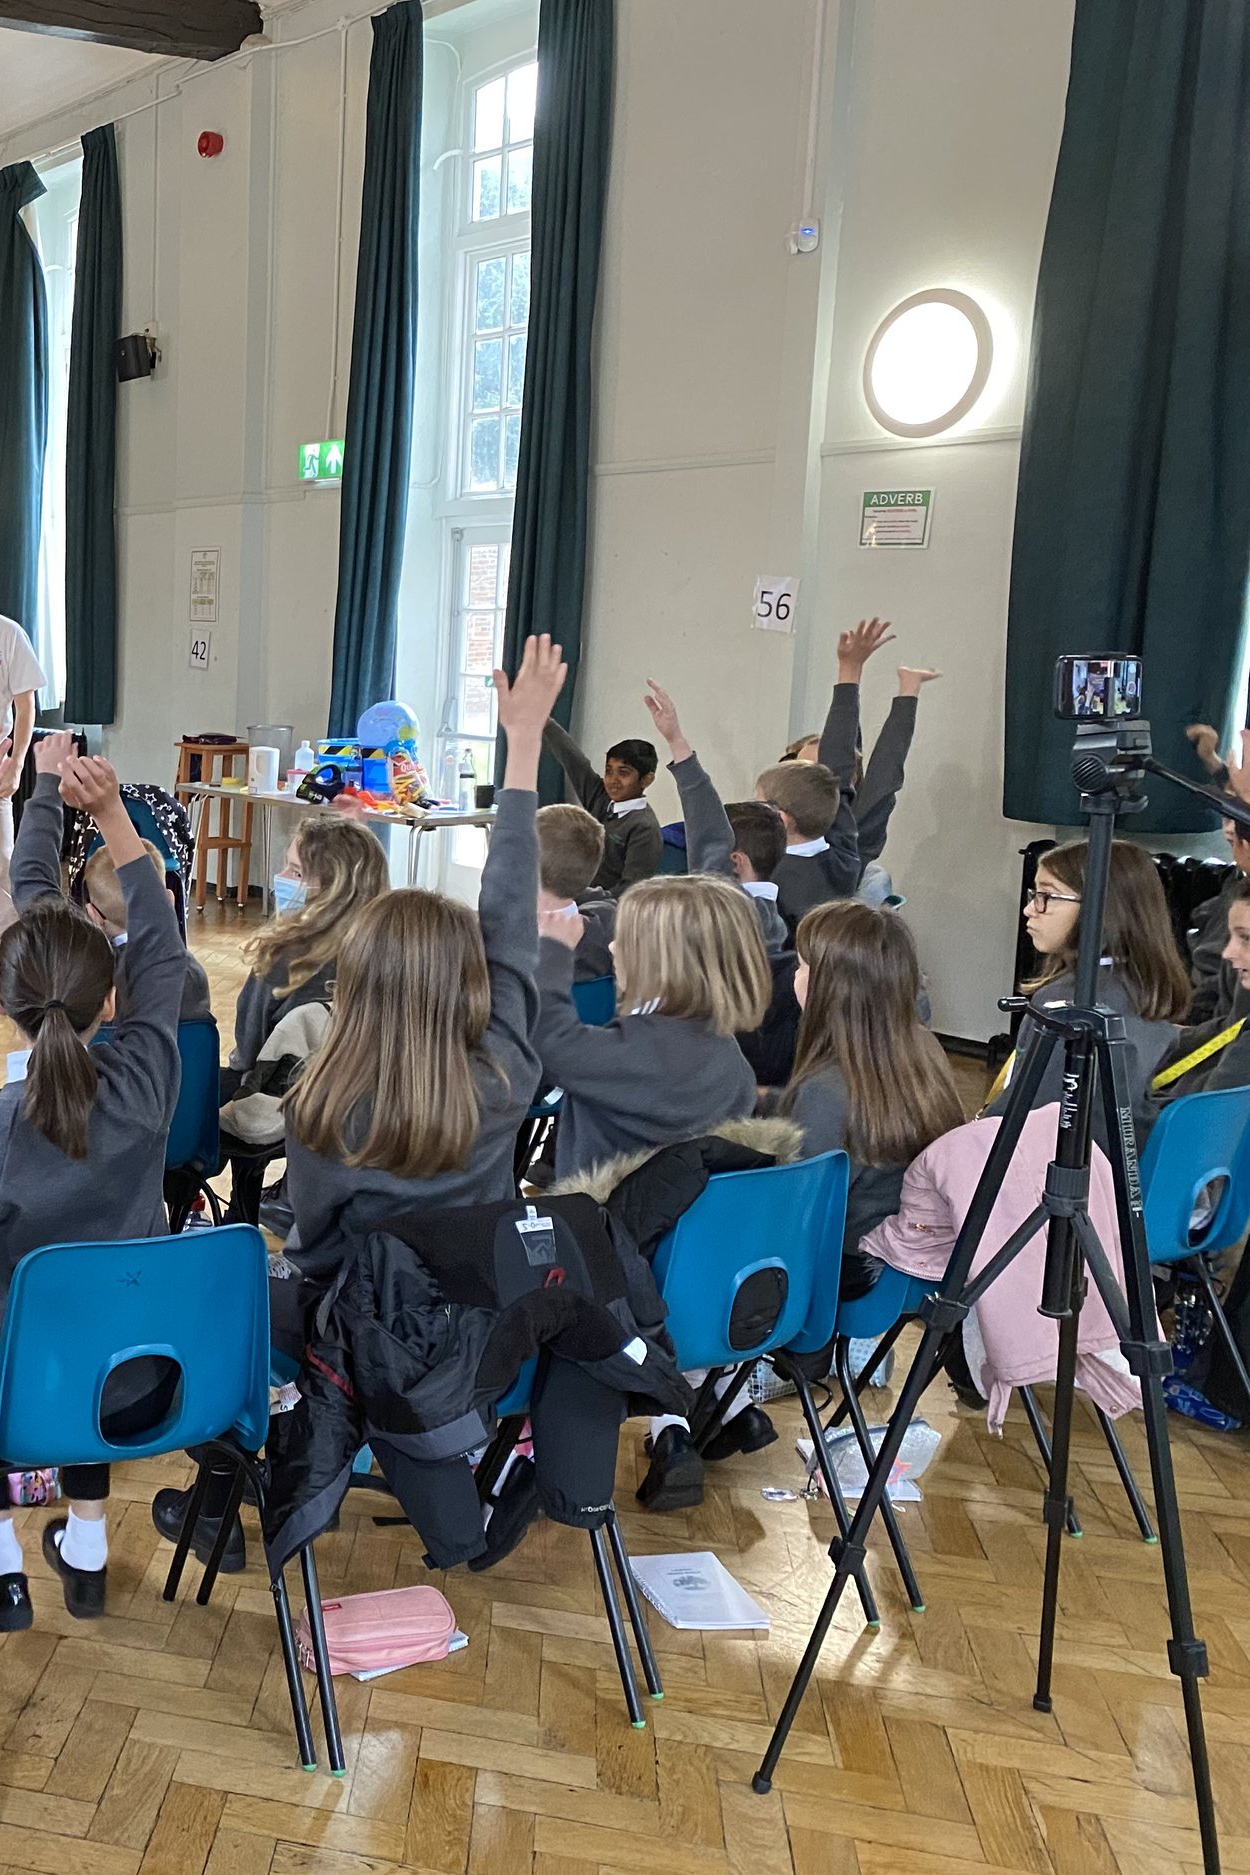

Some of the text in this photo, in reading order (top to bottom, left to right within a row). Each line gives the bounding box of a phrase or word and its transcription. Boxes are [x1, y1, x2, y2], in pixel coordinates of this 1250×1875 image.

[870, 493, 923, 505] ADVERB
[757, 590, 792, 621] 56
[191, 640, 207, 661] 42
[1120, 1106, 1141, 1199] MIRANDA
